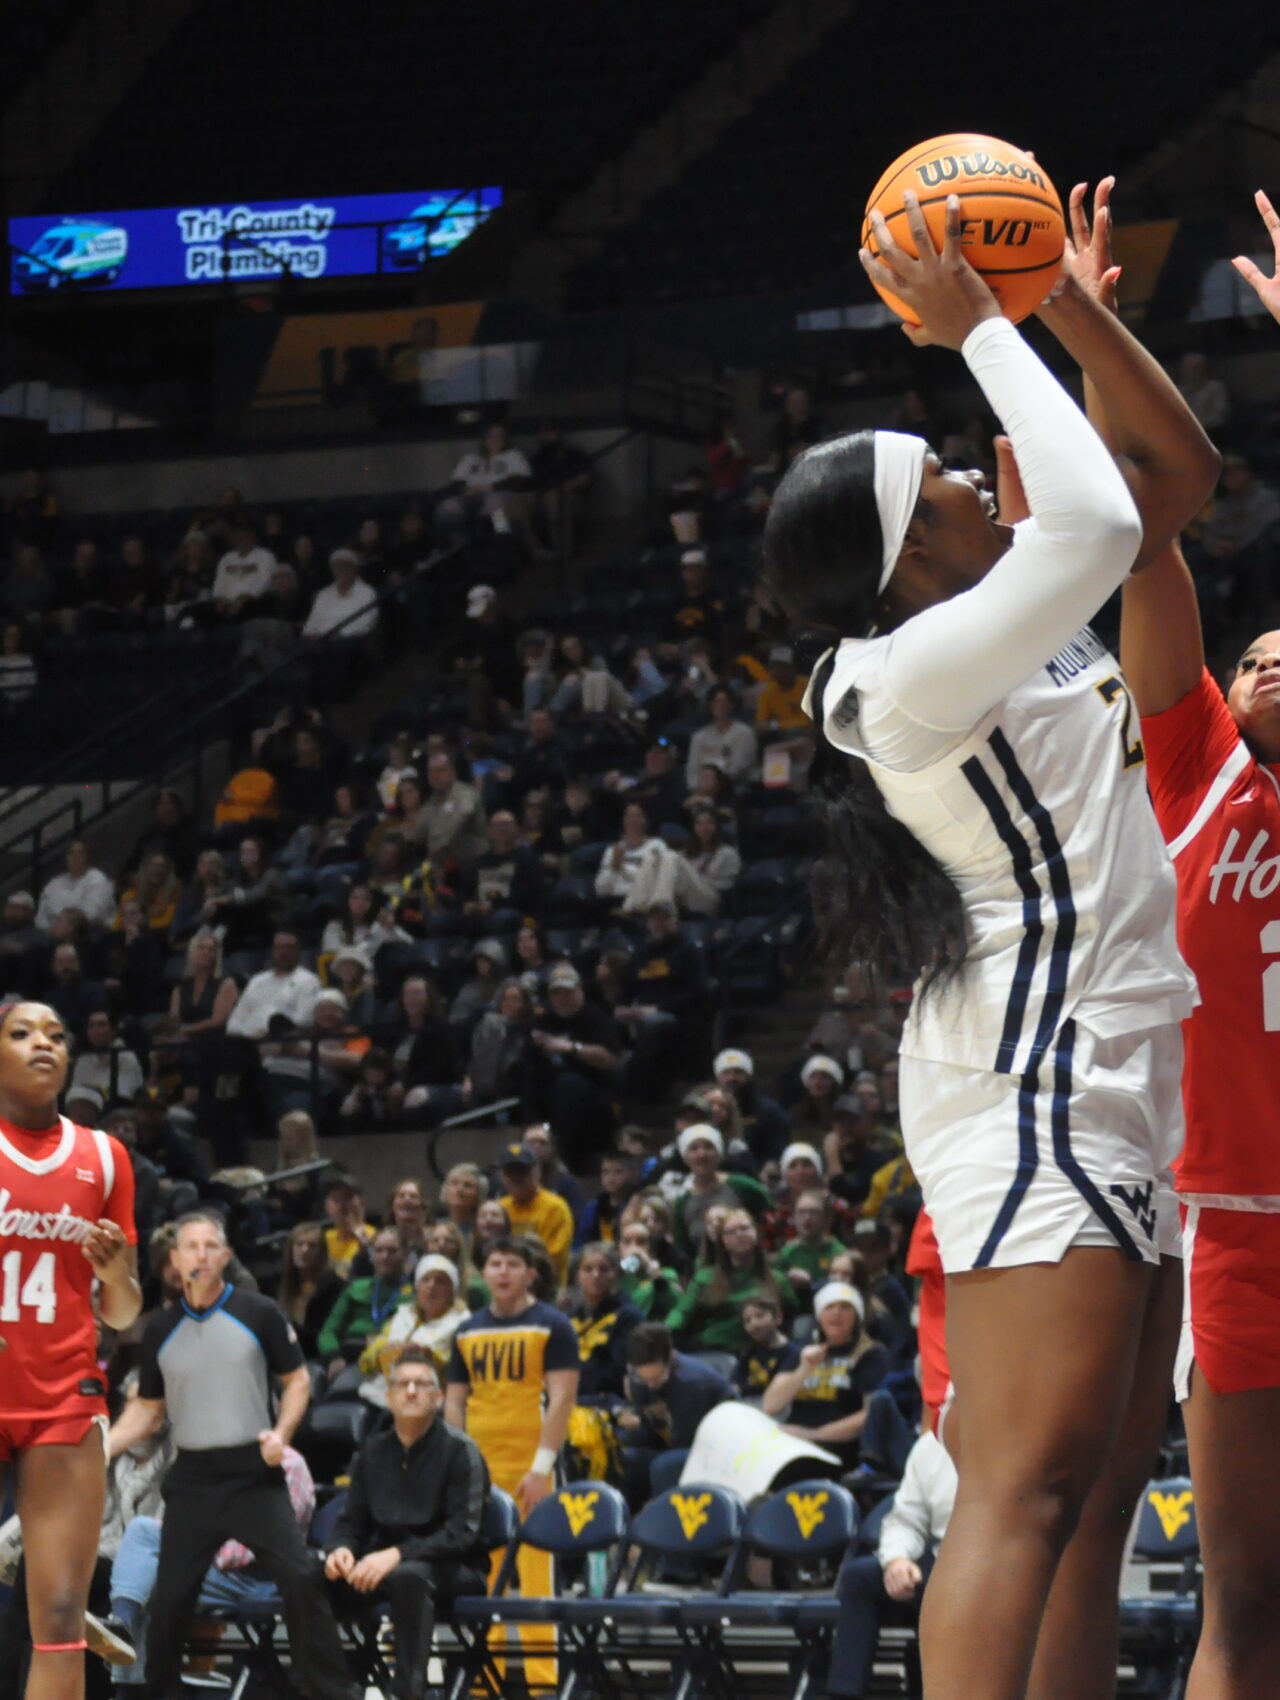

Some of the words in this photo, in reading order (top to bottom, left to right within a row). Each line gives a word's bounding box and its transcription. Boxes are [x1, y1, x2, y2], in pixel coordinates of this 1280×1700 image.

[916, 152, 1047, 192] Wilson
[178, 204, 334, 242] Tri-County
[959, 219, 1033, 246] EVO
[186, 241, 326, 278] Plmbing
[0, 1250, 57, 1324] 14
